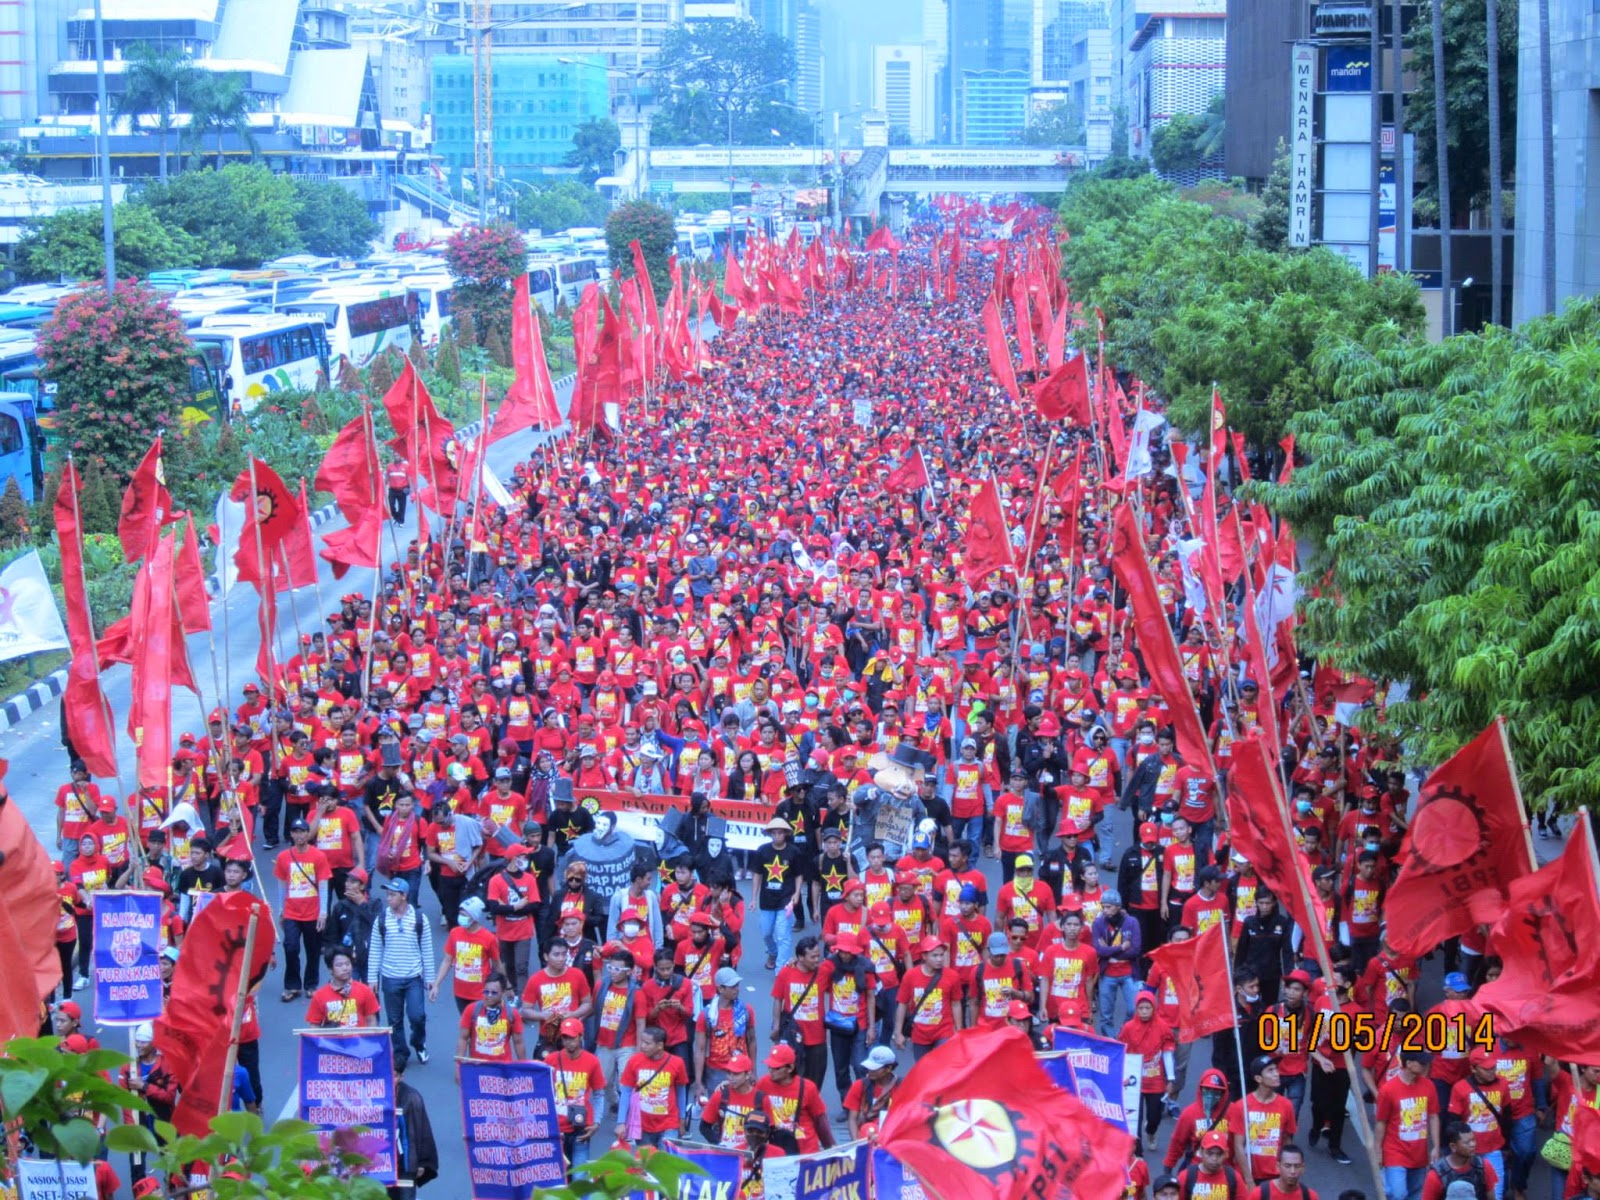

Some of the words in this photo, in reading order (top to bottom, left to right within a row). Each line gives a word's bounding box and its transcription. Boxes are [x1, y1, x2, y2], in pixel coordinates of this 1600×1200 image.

[1331, 67, 1361, 76] mandiri
[1297, 65, 1310, 141] MENARA
[1295, 153, 1307, 243] THAMRIN
[307, 1079, 363, 1100] BERSERIKAT
[366, 1078, 386, 1099] DAN
[479, 1075, 534, 1096] KEBEBASAN
[309, 1104, 384, 1125] BERORGANISASI
[469, 1099, 526, 1119] BERSERIKAT
[527, 1097, 549, 1116] DAN
[474, 1120, 549, 1142] BERORGANISASI
[474, 1147, 509, 1165] UNTUK
[27, 1175, 88, 1185] NASIONAISASI
[510, 1162, 561, 1187] INDONESIA
